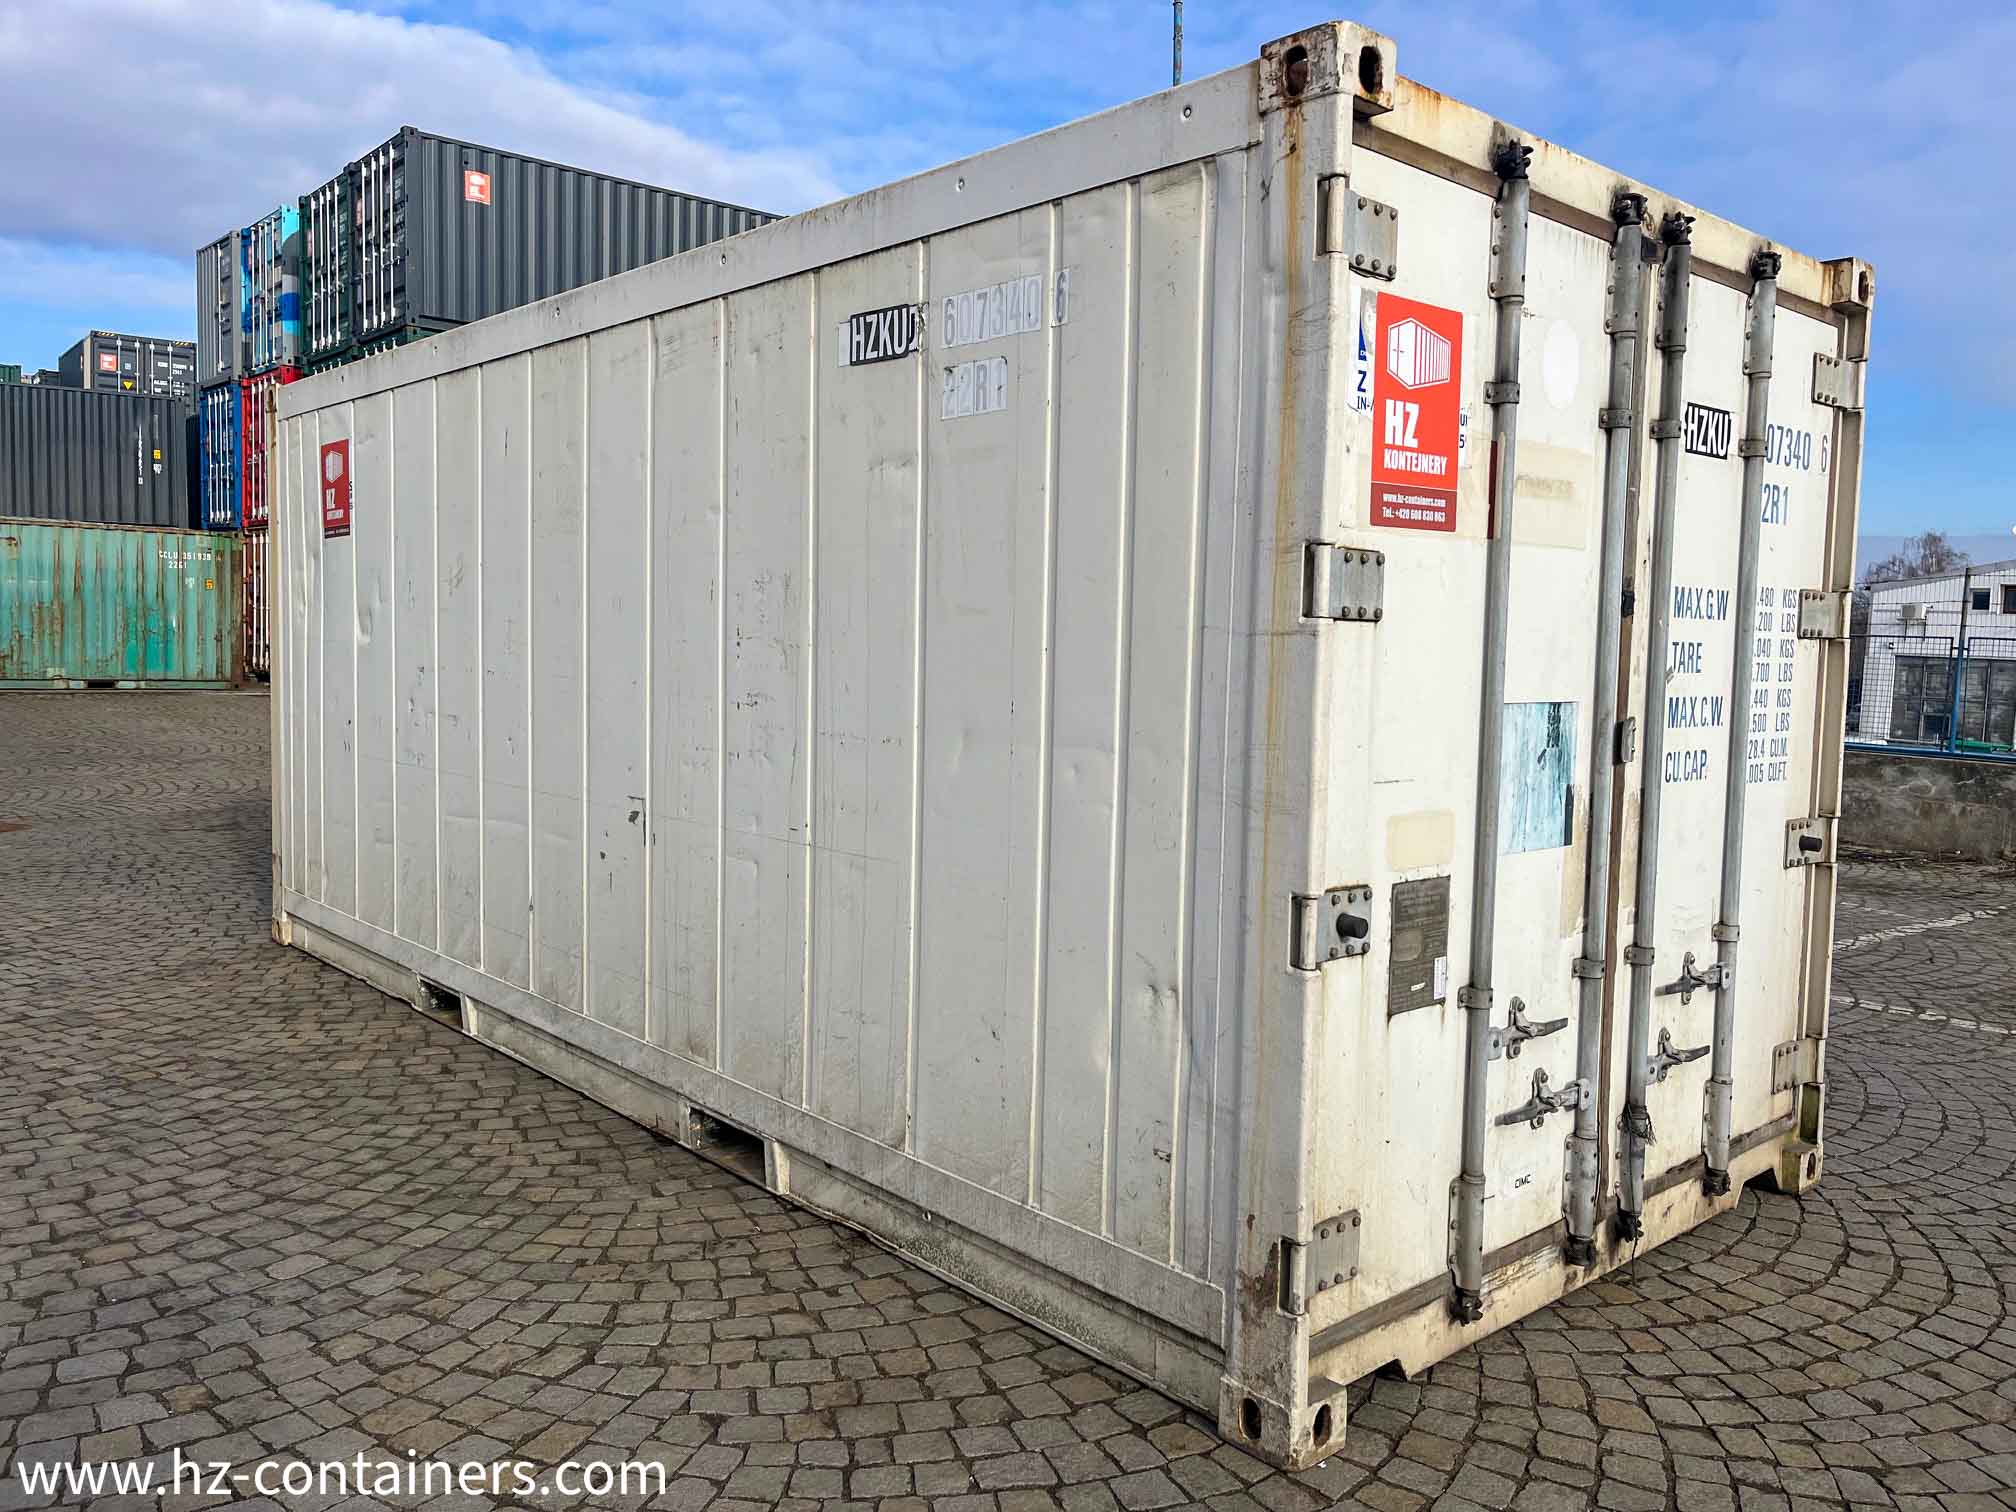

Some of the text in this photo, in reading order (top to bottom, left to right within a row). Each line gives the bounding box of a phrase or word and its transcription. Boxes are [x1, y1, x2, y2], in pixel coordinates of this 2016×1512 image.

[851, 270, 1068, 362] HZKU 607340 6
[1384, 399, 1420, 448] HZ
[1686, 404, 1829, 473] HZKU 07340 6
[1383, 447, 1448, 477] KONTEJNERY
[1760, 483, 1790, 526] 2R1
[1757, 587, 1775, 608] .480
[1782, 588, 1797, 609] KGS
[1755, 611, 1796, 633] .200 LBS
[1672, 638, 1795, 674] TARE .040 KGS
[1752, 662, 1793, 683] .700 LBS
[1751, 688, 1769, 709] .440
[1776, 688, 1792, 709] KGS
[1749, 712, 1790, 733] .500 LBS
[1746, 762, 1764, 784] .005
